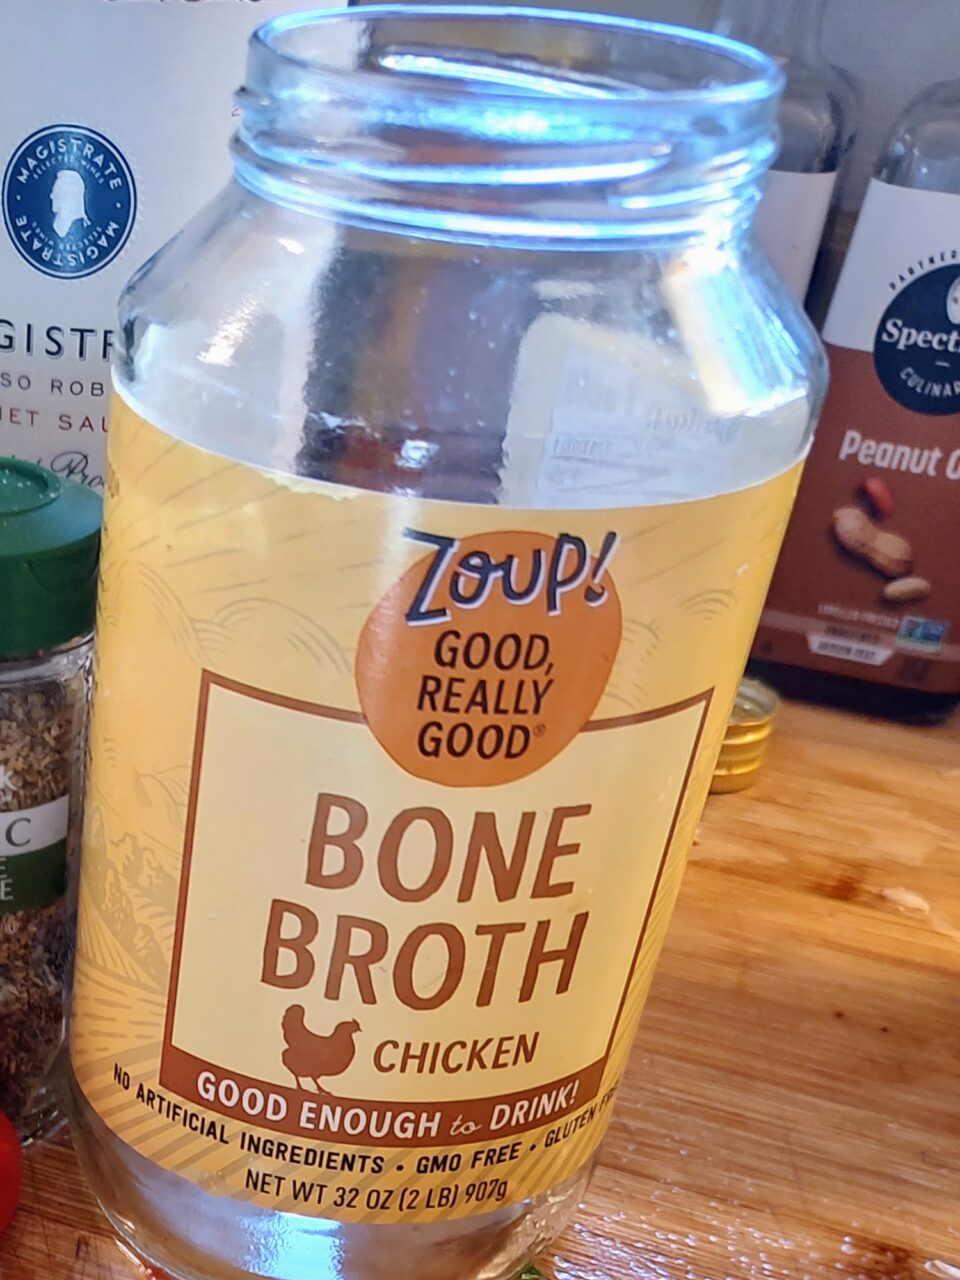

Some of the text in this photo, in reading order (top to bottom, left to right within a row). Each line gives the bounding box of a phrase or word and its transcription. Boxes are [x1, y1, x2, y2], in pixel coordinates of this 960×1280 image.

[17, 138, 122, 190] MAGISTRATE
[16, 216, 119, 266] MAGISTRATE
[881, 318, 960, 353] Spect
[840, 430, 942, 477] Peanut
[434, 629, 554, 676] GOOD,
[417, 675, 554, 715] REALLY
[305, 792, 592, 902] BONE
[260, 898, 589, 1011] BROTH
[372, 1032, 540, 1075] CHICKEN
[114, 1062, 130, 1090] NO
[136, 1083, 230, 1145] ARTIFICIAL
[240, 1132, 385, 1174] INGREDIENTS
[416, 1153, 461, 1175] GMO
[471, 1141, 523, 1169] FREE
[544, 1104, 597, 1148] GLUTEN
[197, 1071, 580, 1139] GOOD ENOUGH to DRINK!
[245, 1168, 508, 1212] NET WT 32 OZ (2 LB) 907g
